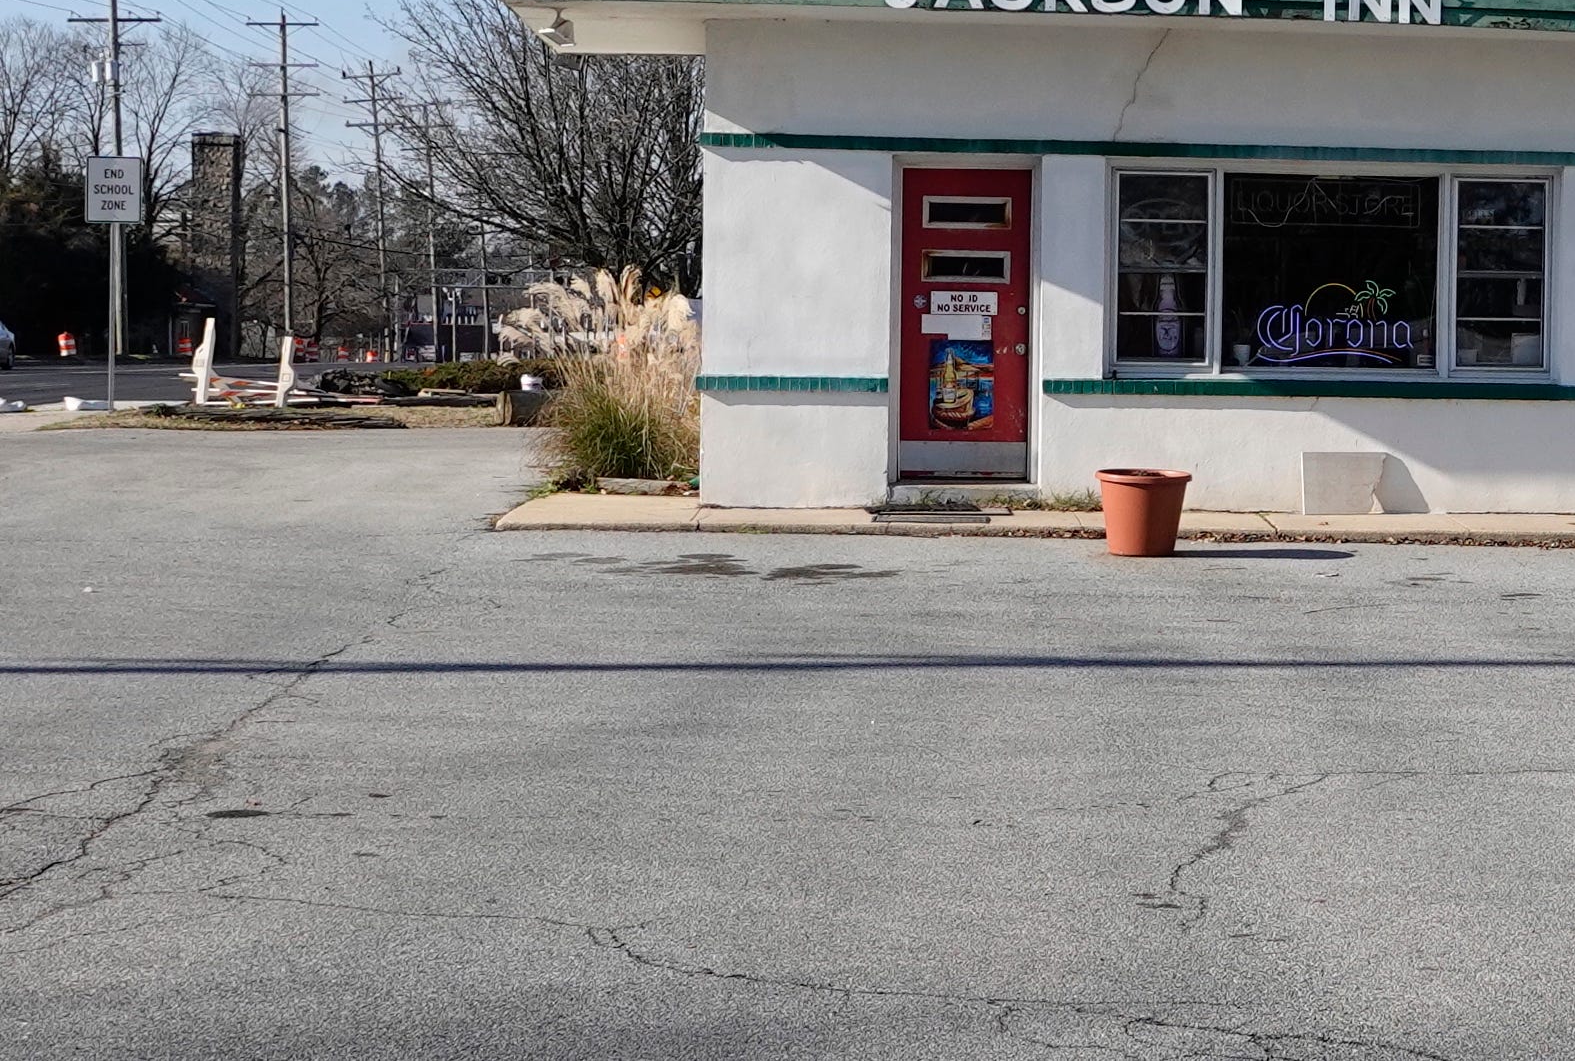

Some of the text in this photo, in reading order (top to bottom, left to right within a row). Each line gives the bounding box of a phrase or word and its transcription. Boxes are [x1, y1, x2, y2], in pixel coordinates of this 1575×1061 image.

[104, 168, 124, 179] END
[94, 184, 134, 195] SCHOOL
[101, 200, 126, 210] ZONE
[1237, 190, 1329, 213] LIQUOR
[950, 294, 978, 303] NO ID
[937, 303, 991, 313] NO SERVICE
[1257, 304, 1414, 356] Corona
